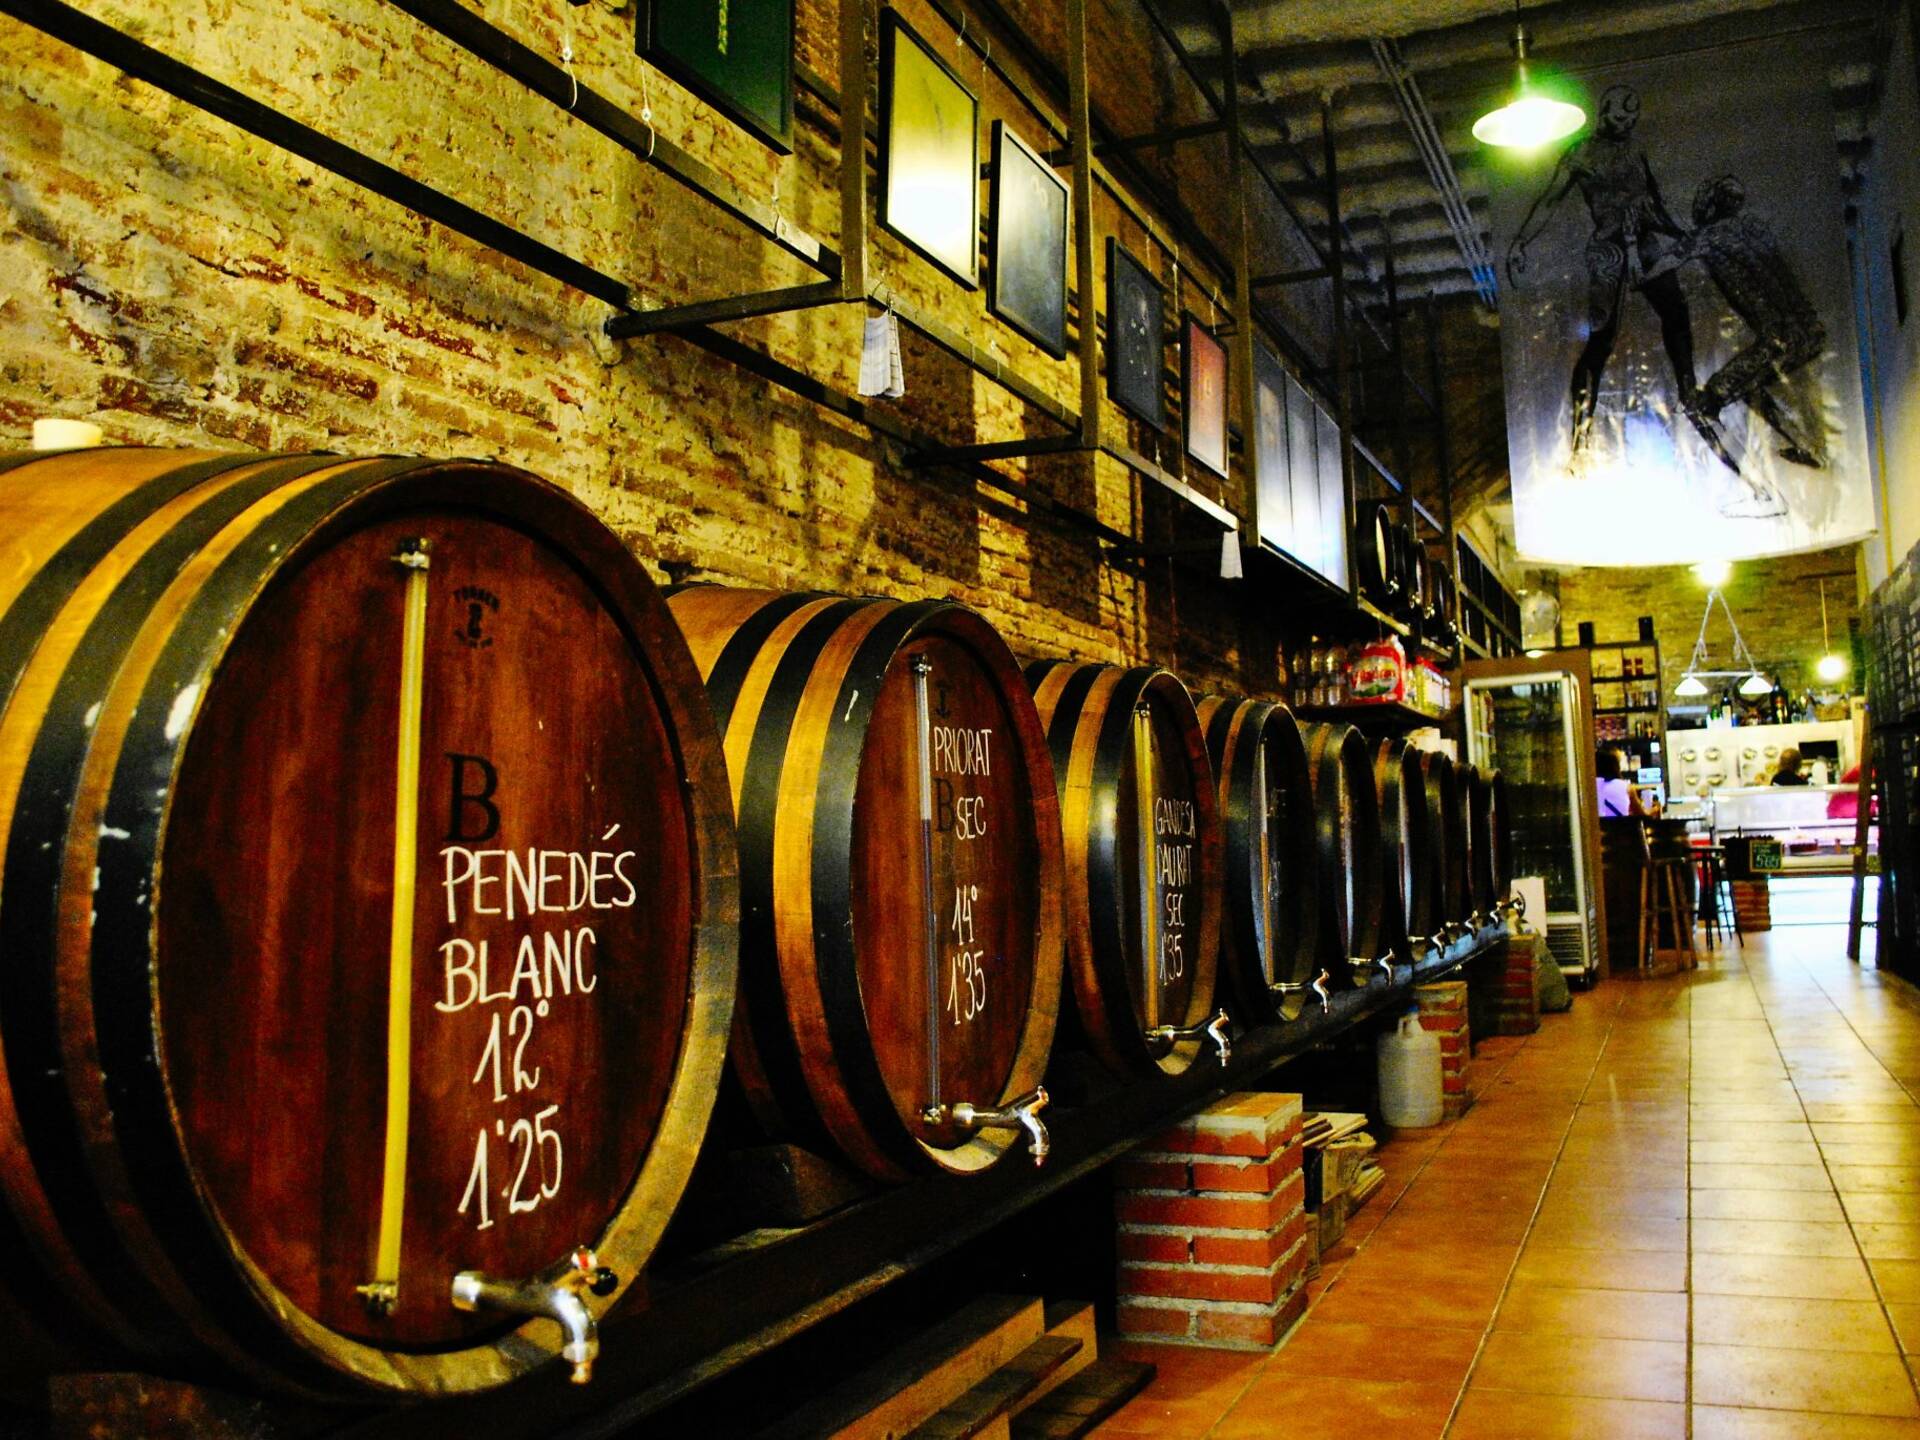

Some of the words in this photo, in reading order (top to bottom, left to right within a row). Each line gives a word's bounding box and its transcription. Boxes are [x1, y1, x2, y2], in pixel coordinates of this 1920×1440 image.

[934, 726, 993, 776] PRIORAT
[443, 753, 501, 842] B
[956, 796, 987, 841] SEC
[1155, 797, 1196, 839] GANDESA
[439, 823, 636, 923] PENEDÉS
[1166, 892, 1185, 927] SEC
[434, 927, 597, 1013] BLANC
[947, 950, 986, 1026] 1'35
[457, 1105, 563, 1230] 1'25
